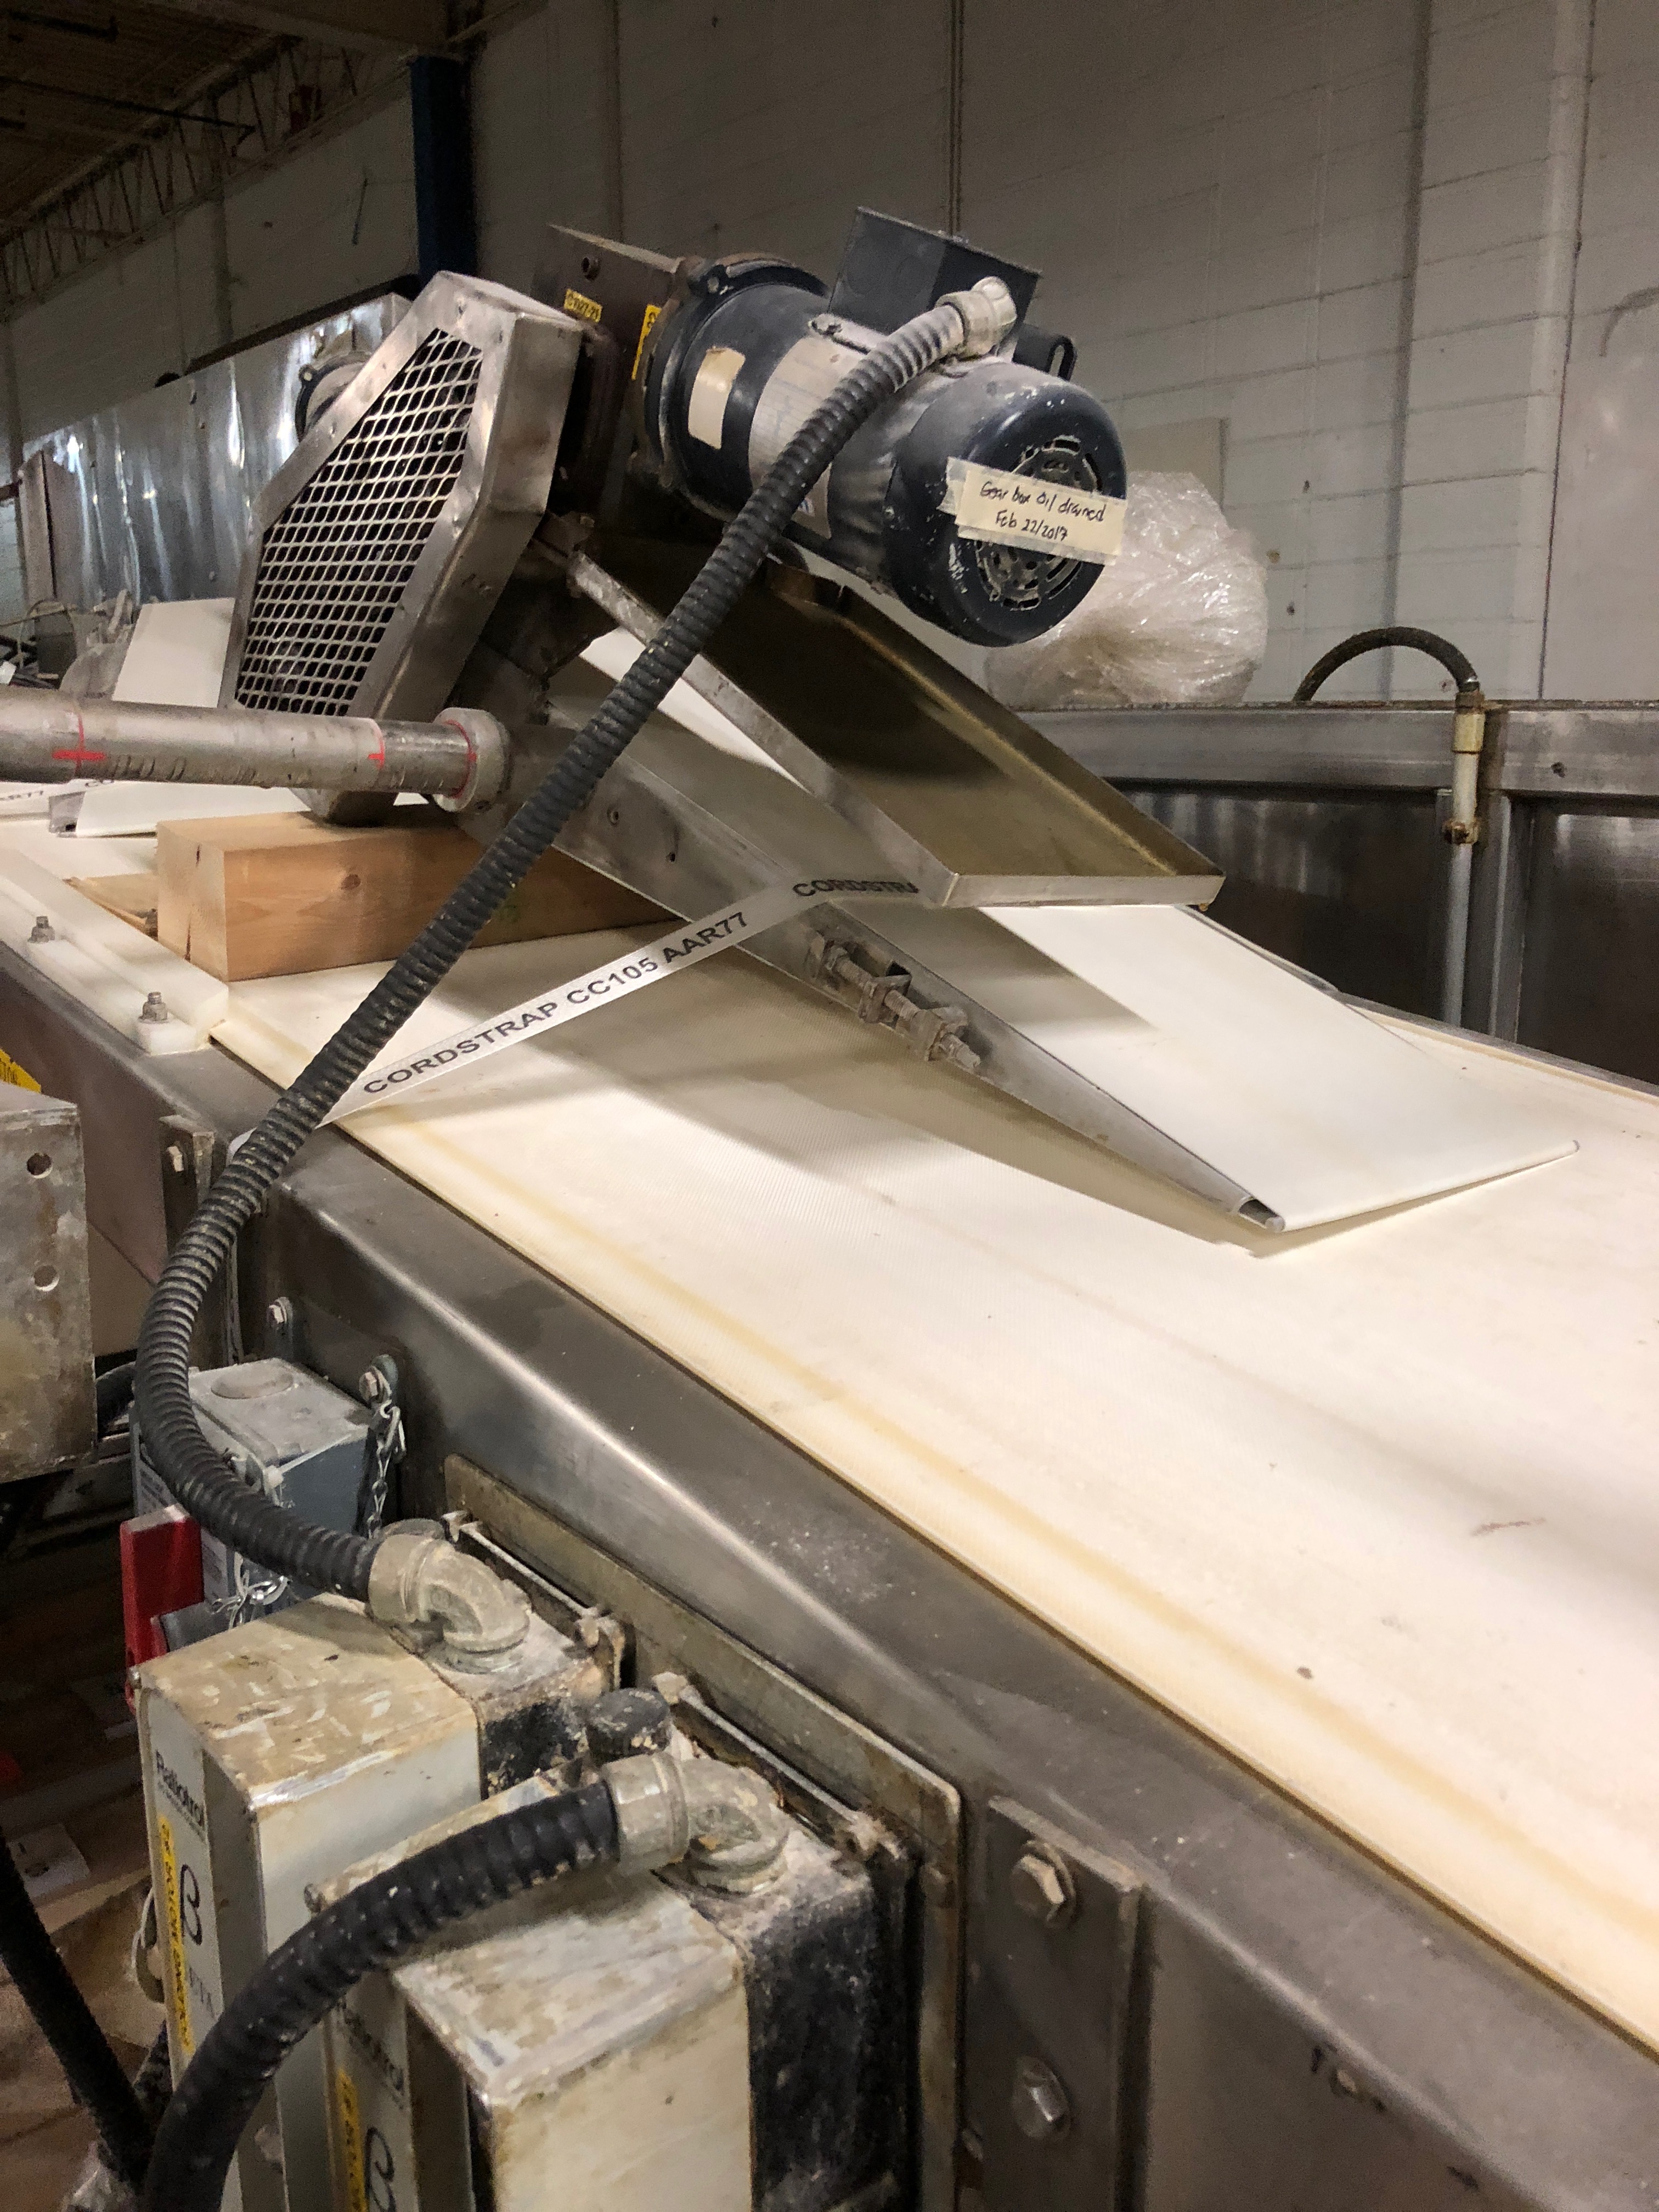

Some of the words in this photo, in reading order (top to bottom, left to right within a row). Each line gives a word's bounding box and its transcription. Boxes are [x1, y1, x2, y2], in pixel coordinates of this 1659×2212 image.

[980, 482, 1009, 500] Gear
[1012, 486, 1031, 504] box
[1037, 492, 1057, 512] Oil
[1057, 497, 1107, 522] drained
[996, 510, 1017, 528] Feb
[1021, 518, 1069, 541] 22/2017
[364, 1002, 557, 1093] CORDSTRAP
[567, 957, 658, 1004] CC105
[662, 911, 747, 963] AAR77
